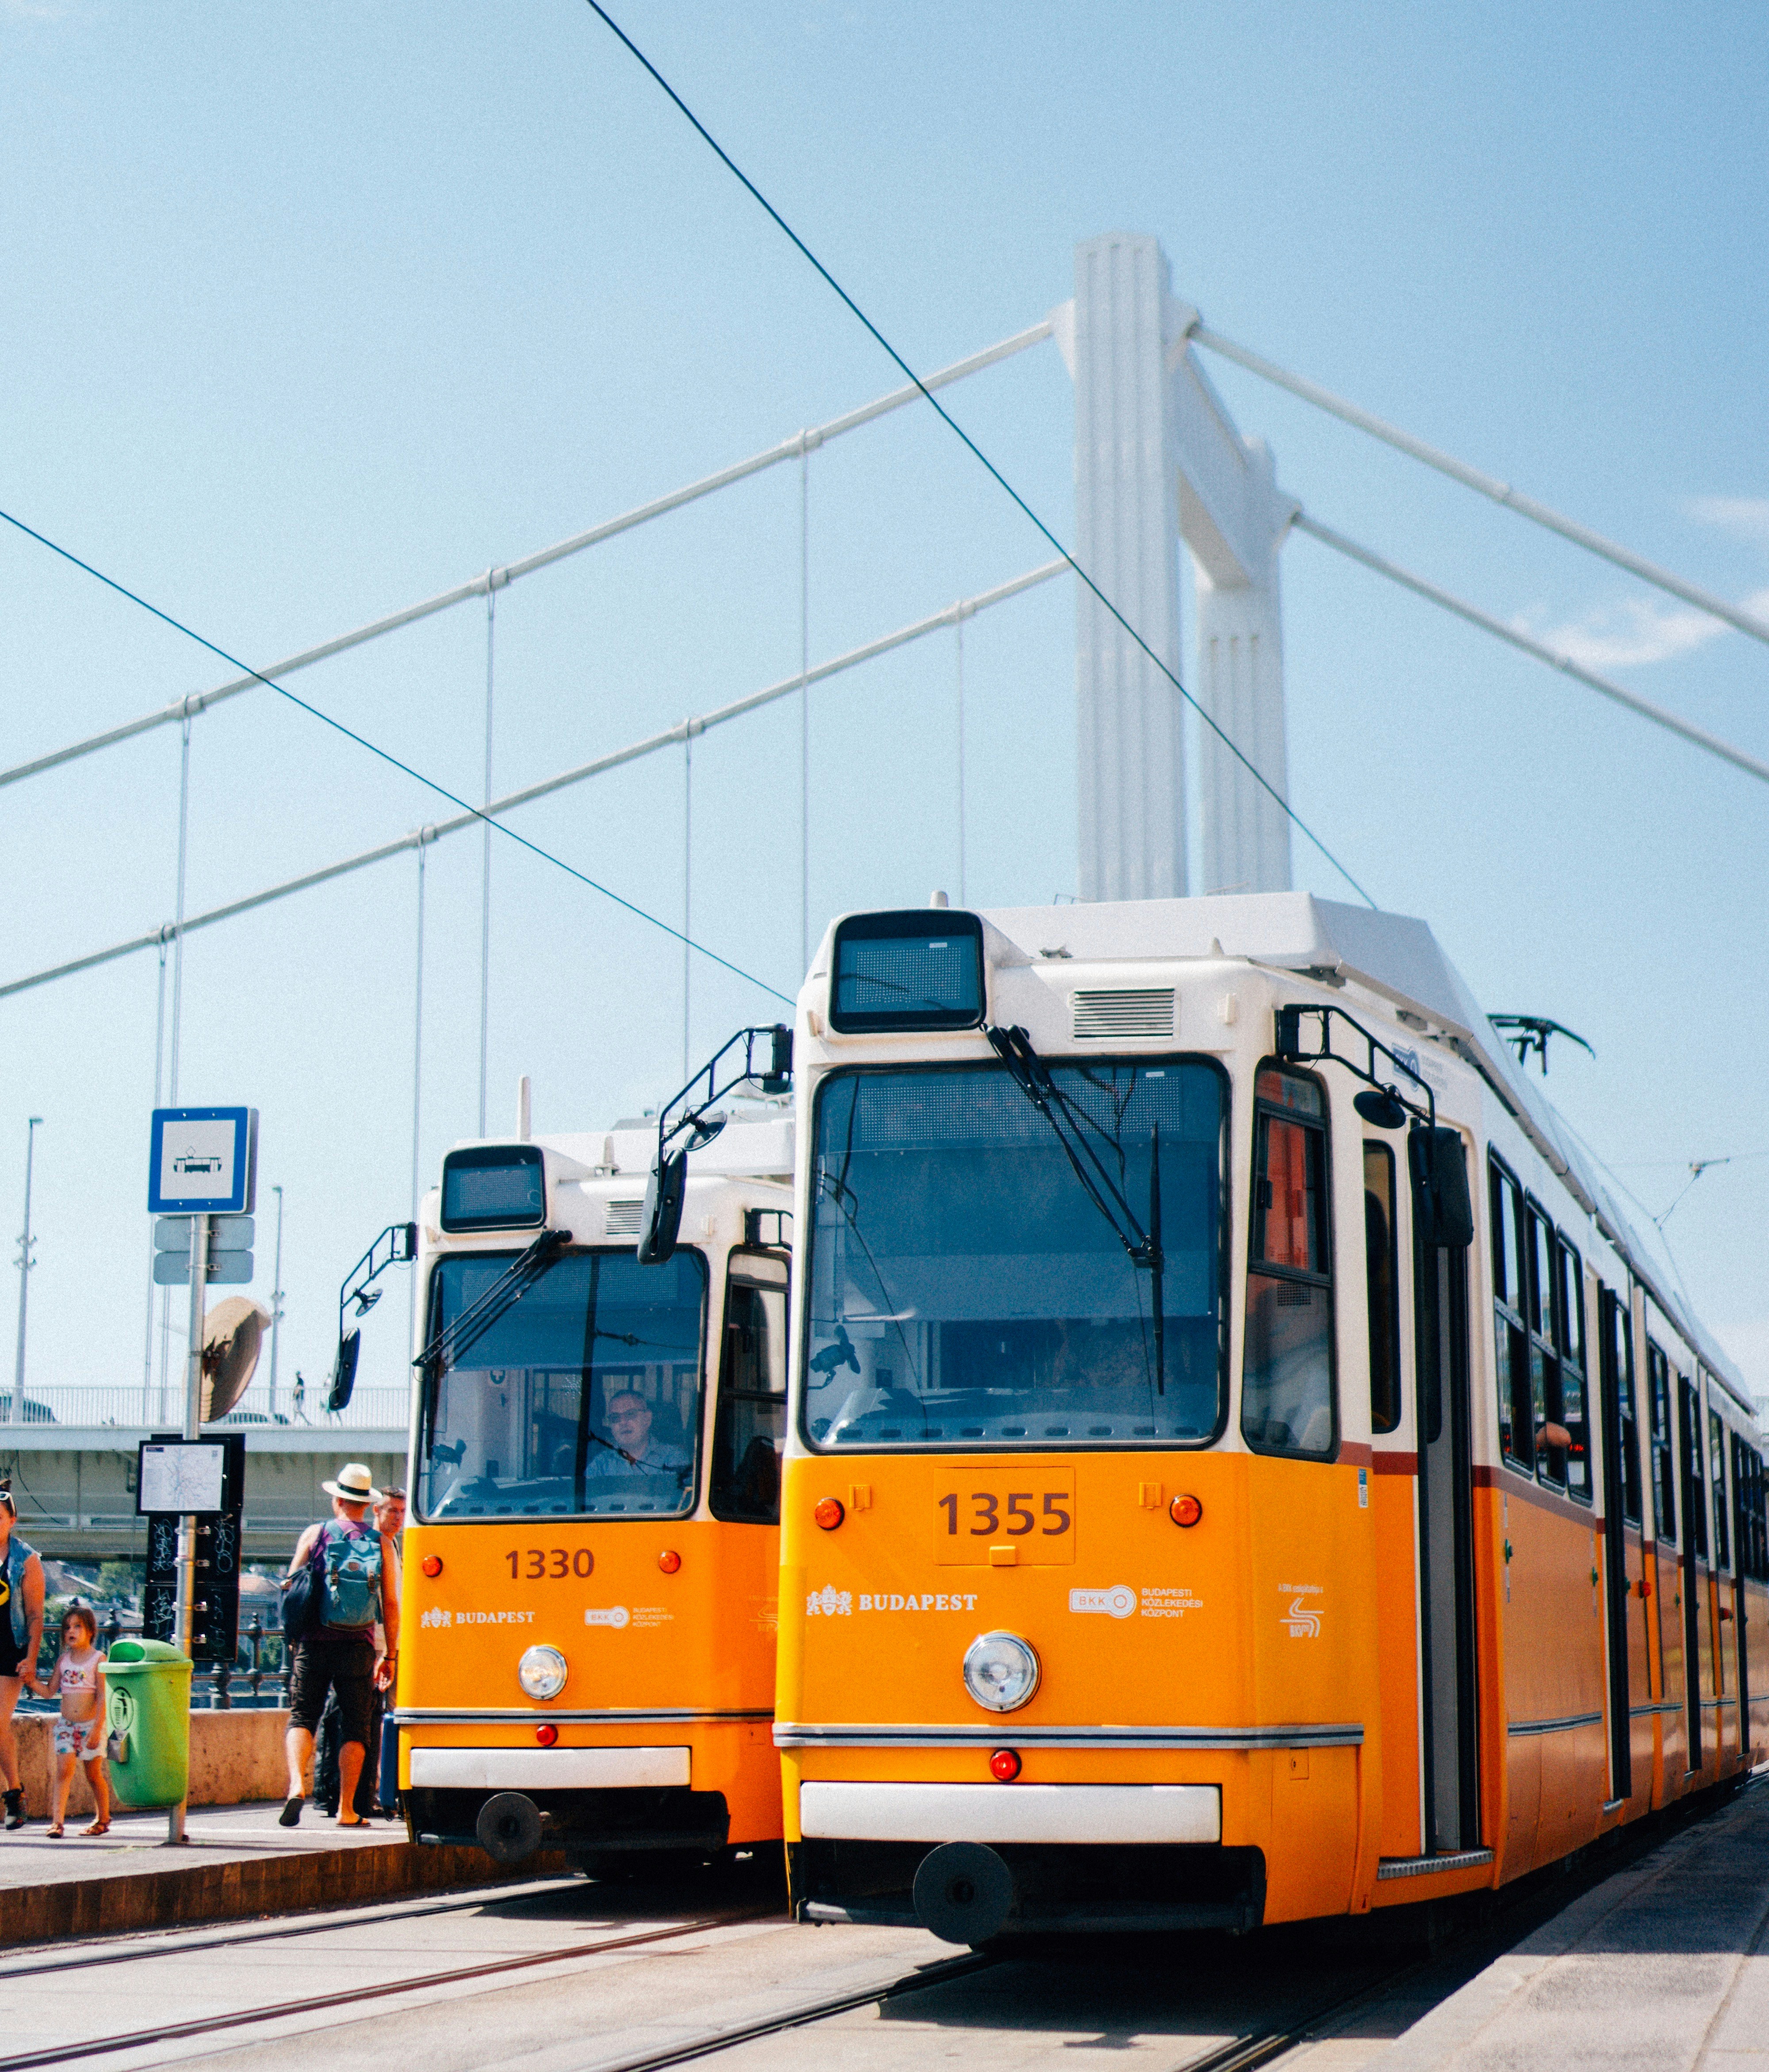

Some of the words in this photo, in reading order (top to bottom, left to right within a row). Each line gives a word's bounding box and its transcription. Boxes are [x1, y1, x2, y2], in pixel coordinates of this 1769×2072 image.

[938, 1493, 1070, 1535] 1355
[506, 1549, 594, 1579] 1330
[1141, 1588, 1192, 1597] BUDAPESTI
[859, 1594, 977, 1611] BUDAPEST
[1079, 1596, 1106, 1605] BKK
[1141, 1597, 1203, 1608] KÖZLEKEDÉSI
[456, 1612, 535, 1623] BUDAPEST
[1141, 1608, 1184, 1617] KÖZPONT
